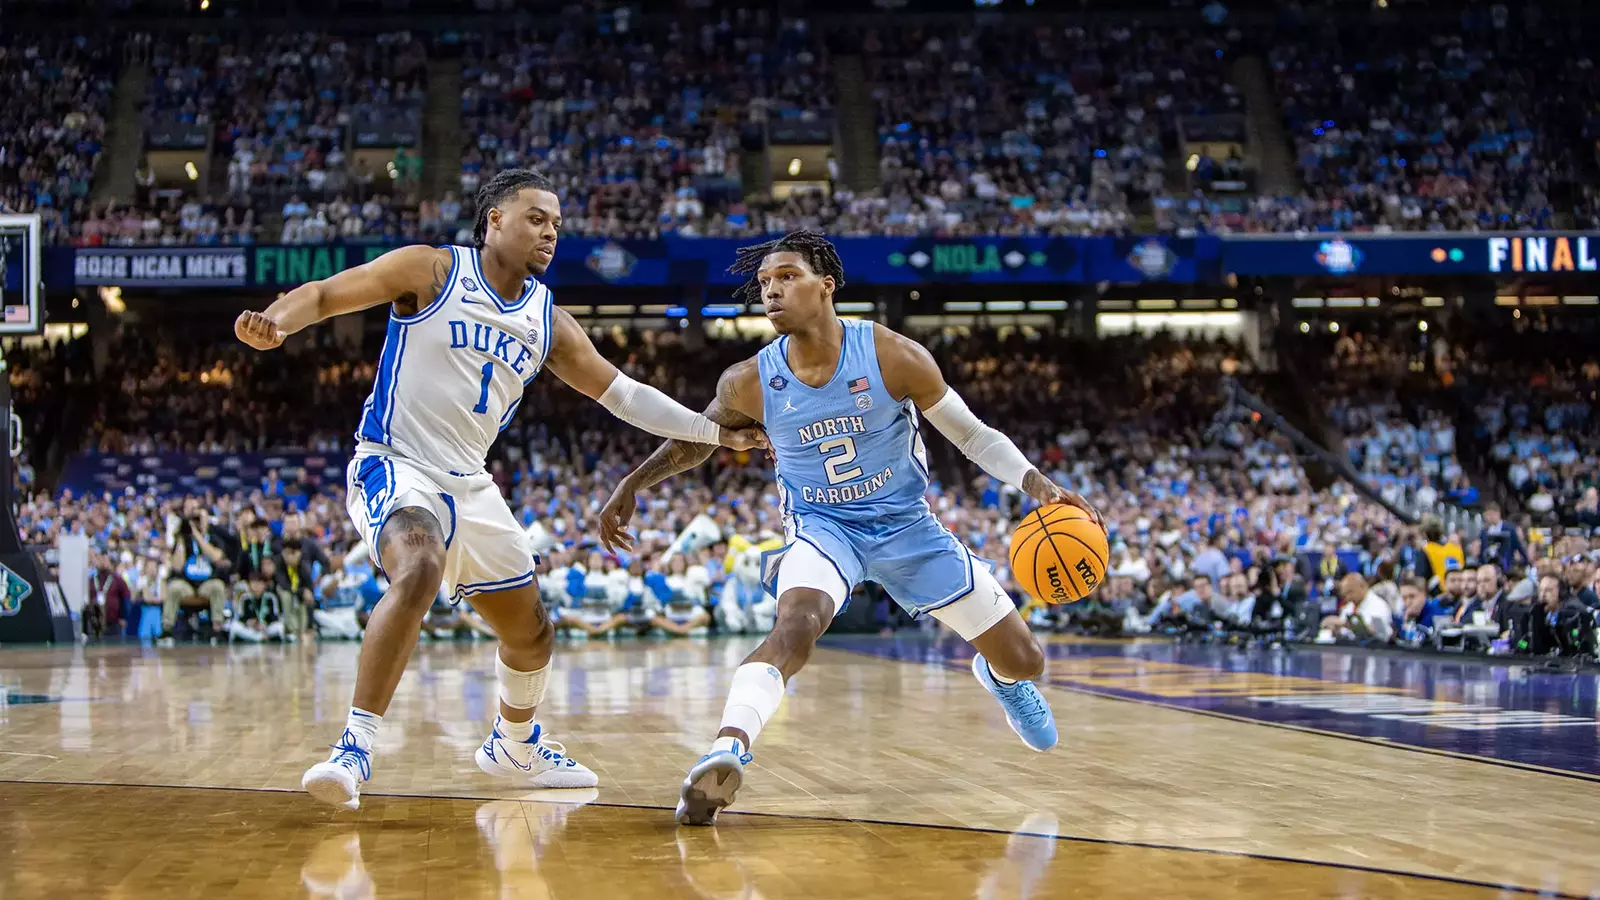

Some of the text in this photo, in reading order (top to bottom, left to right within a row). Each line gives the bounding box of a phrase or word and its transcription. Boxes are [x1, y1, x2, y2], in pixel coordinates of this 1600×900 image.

[75, 255, 246, 277] 2022 NCAA MEN'S
[932, 244, 1001, 272] NOLA
[1488, 237, 1597, 272] FINAL
[449, 320, 532, 375] DUKE
[473, 361, 494, 414] 1
[797, 416, 866, 445] NORTH
[818, 436, 864, 485] 2
[802, 467, 893, 504] CAROLINA
